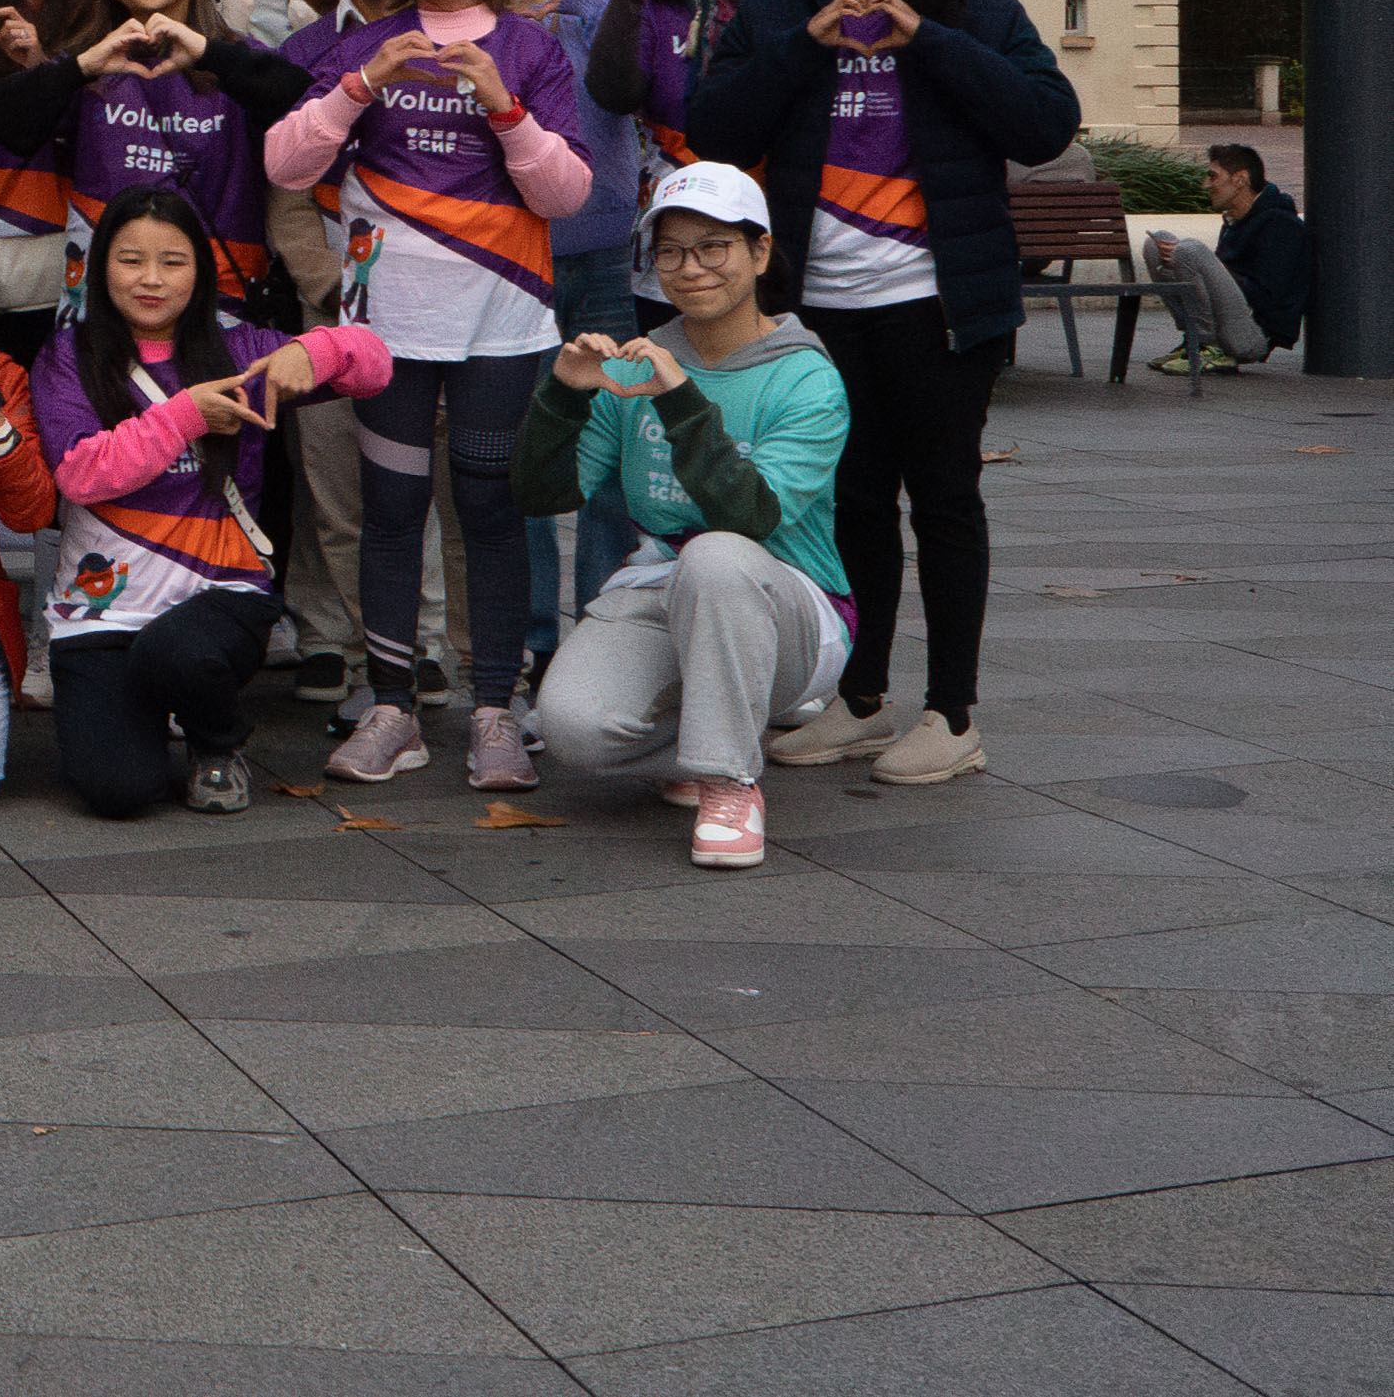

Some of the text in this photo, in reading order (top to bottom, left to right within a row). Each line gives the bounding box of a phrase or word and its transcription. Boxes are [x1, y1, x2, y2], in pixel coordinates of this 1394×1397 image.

[381, 87, 490, 117] Volunte
[105, 103, 226, 134] Volunteer
[406, 139, 457, 154] SCHF
[124, 155, 175, 173] SCHF
